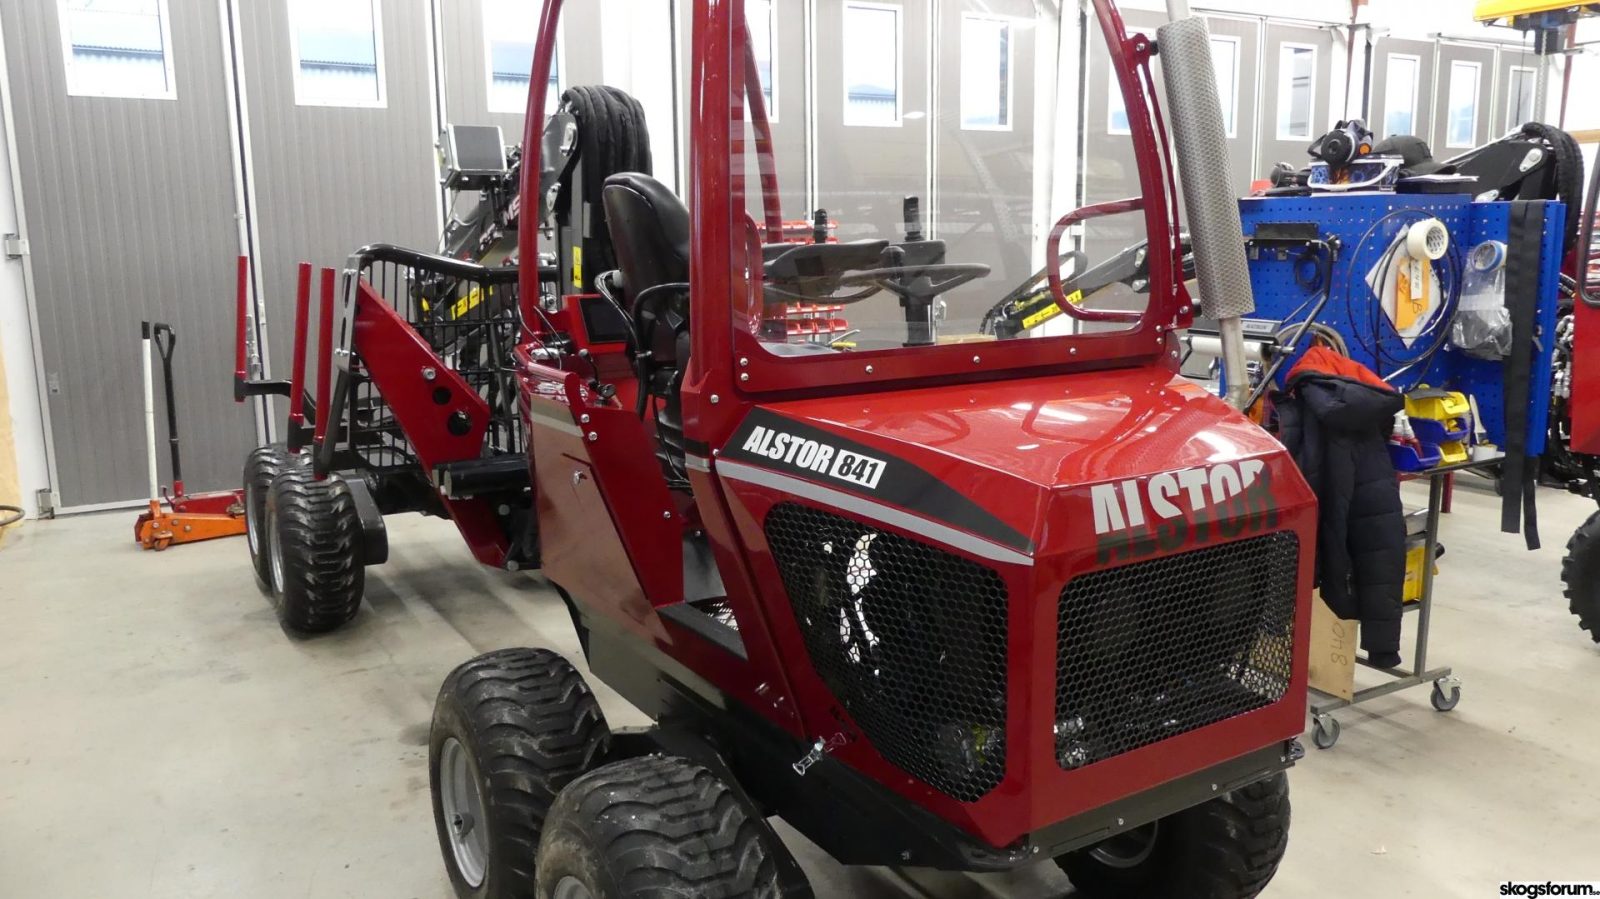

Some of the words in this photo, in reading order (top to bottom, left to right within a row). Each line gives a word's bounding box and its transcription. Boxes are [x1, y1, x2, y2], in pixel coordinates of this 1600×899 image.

[742, 426, 834, 474] ALSTOR
[838, 455, 879, 484] 841
[1091, 459, 1279, 565] ALSTOR
[1323, 622, 1347, 665] 840
